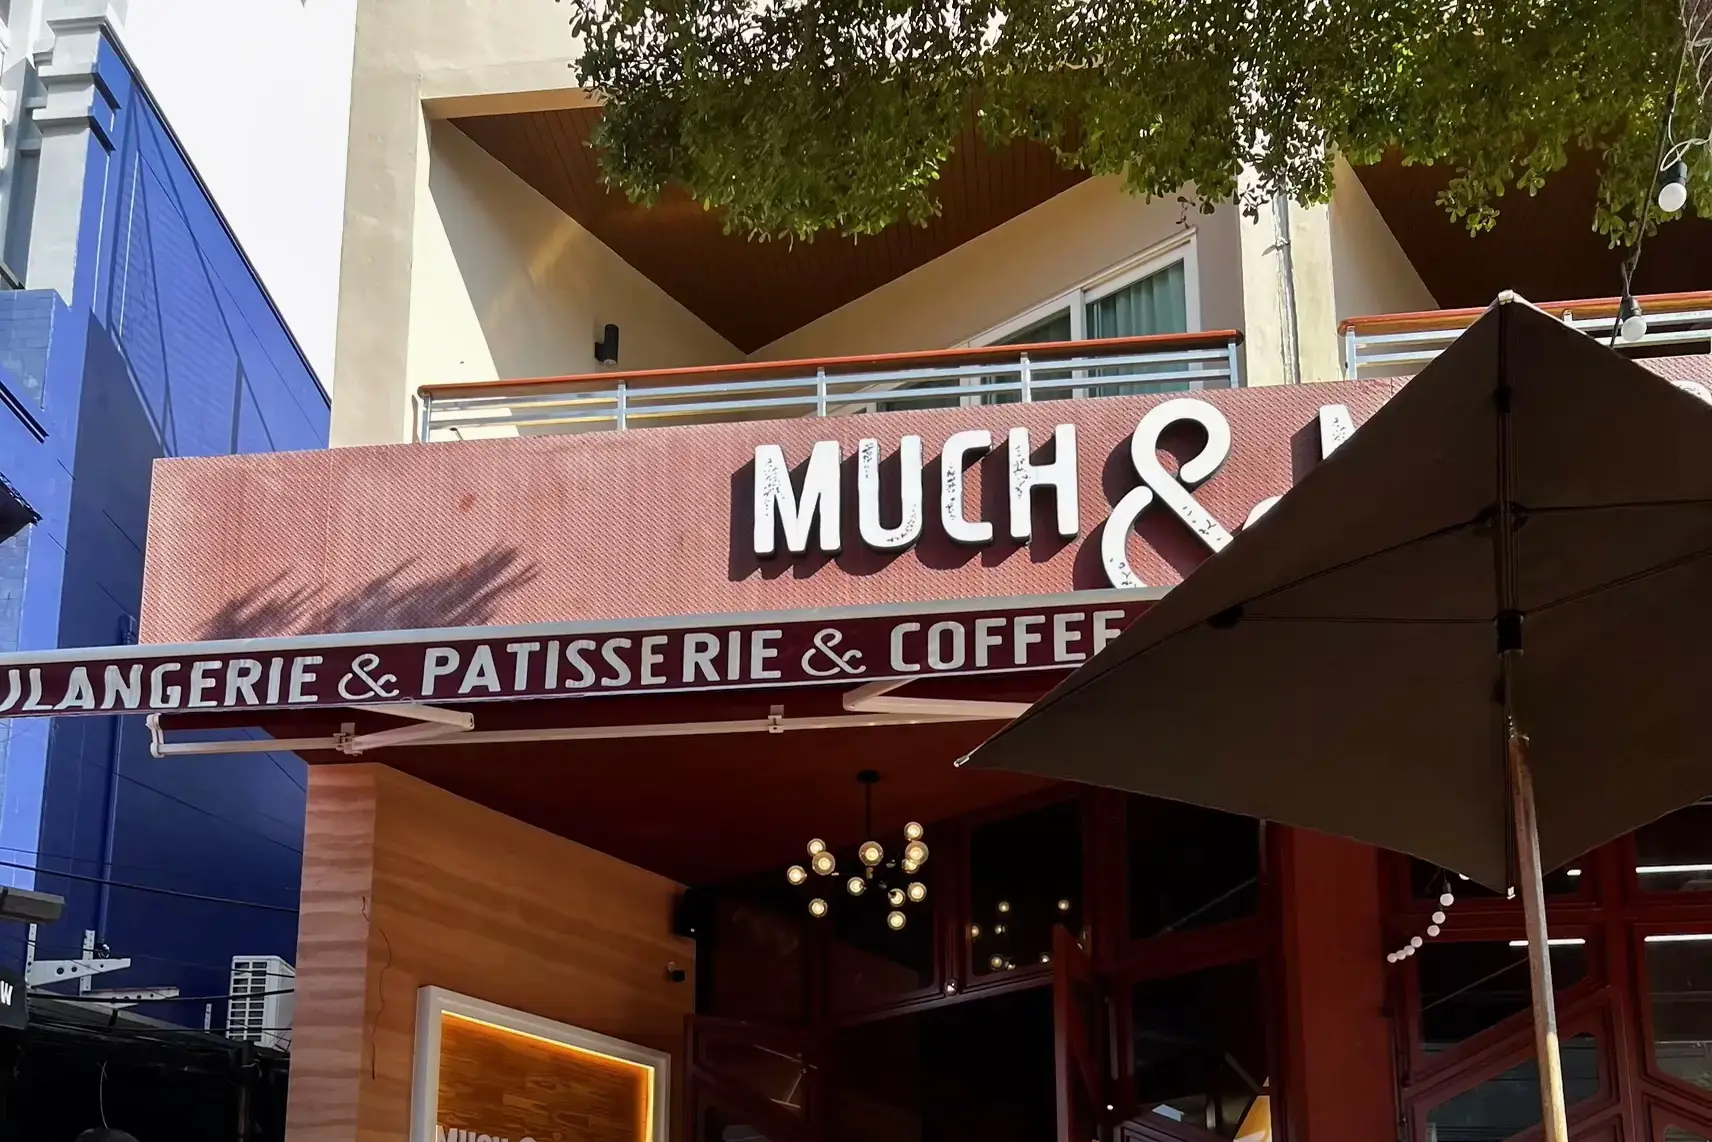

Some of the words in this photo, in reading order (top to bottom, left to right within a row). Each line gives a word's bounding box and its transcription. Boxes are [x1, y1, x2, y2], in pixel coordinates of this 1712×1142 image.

[754, 423, 1081, 556] MUCH
[338, 653, 399, 699] &
[421, 629, 785, 696] PATISSERIE
[801, 628, 867, 677] &
